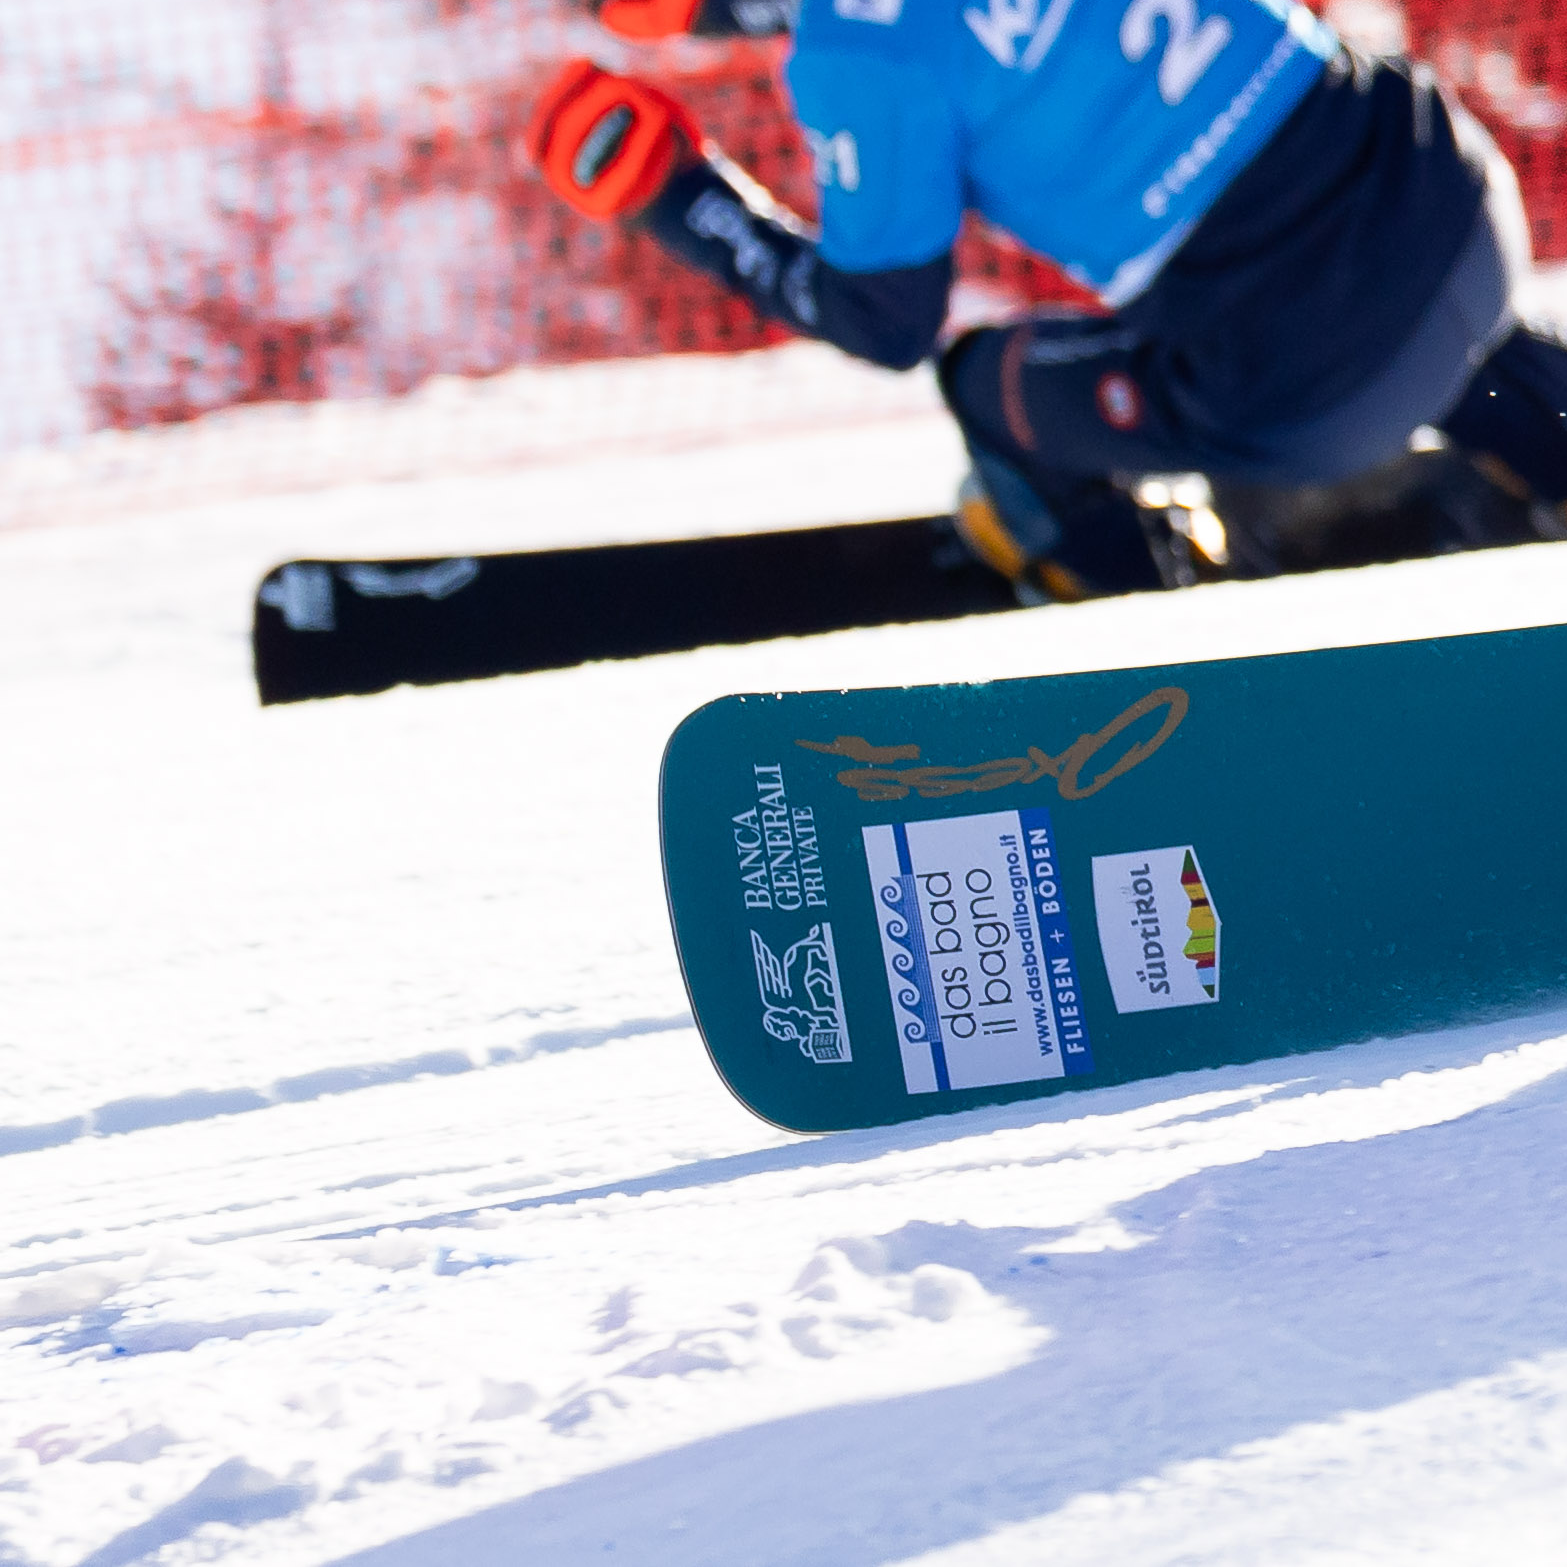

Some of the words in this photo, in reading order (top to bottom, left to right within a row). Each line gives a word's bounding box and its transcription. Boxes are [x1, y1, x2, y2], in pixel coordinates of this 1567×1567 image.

[732, 806, 773, 910] BANCA
[754, 762, 802, 911] GENERALI
[792, 805, 828, 908] PRIVATE
[1029, 828, 1061, 914] BÖDEN
[916, 871, 963, 955] bad
[965, 868, 1013, 1006] bagno
[999, 834, 1054, 1057] www.dasbadilbagno.it
[1050, 929, 1065, 945] +
[941, 966, 977, 1039] das
[981, 1018, 1018, 1036] il
[1052, 957, 1085, 1054] FLIESEN
